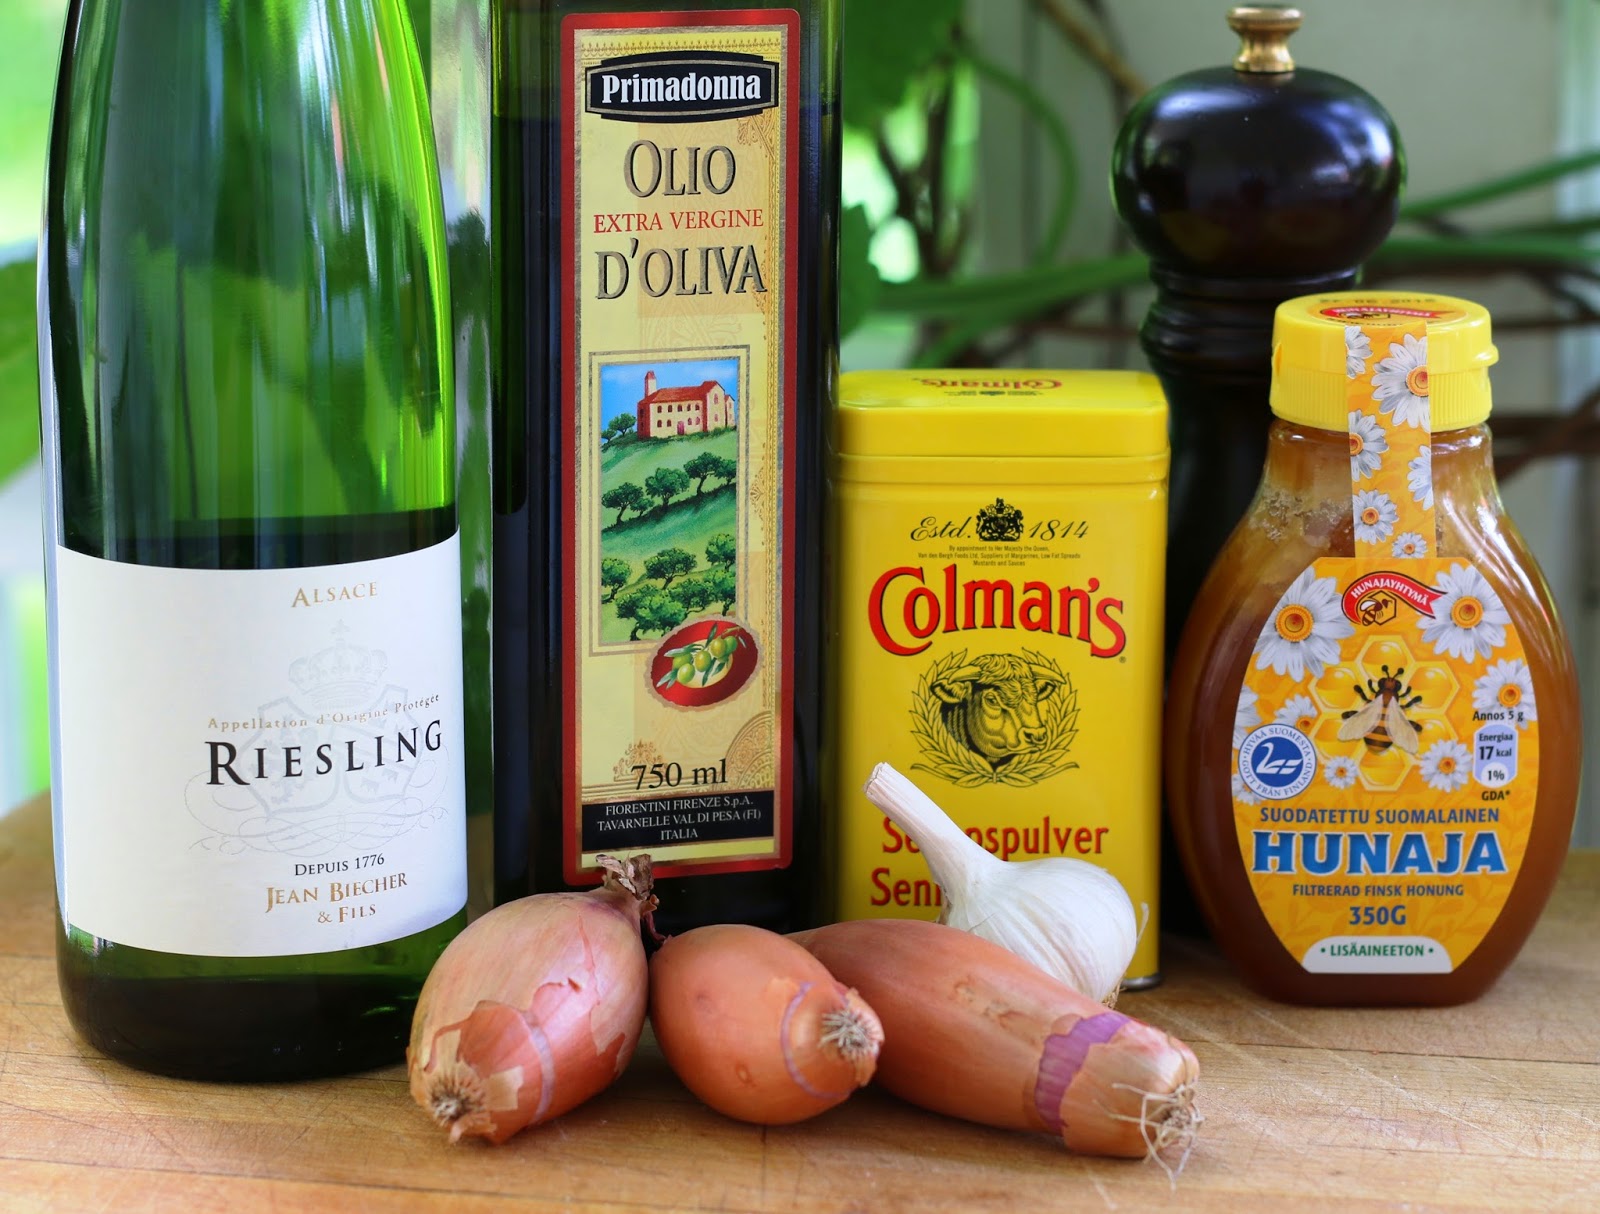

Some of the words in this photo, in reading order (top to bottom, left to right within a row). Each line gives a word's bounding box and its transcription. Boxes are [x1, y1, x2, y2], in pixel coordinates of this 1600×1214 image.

[601, 72, 761, 104] Primadonna
[624, 139, 736, 198] OLIO
[593, 212, 663, 233] EXTRA
[669, 209, 764, 230] VERGINE
[595, 237, 767, 300] D'OLIVA
[910, 516, 972, 542] Estd.
[1028, 519, 1089, 542] 1814
[291, 581, 379, 608] ALSACE
[1350, 577, 1429, 605] HUNAJAYHTYMÄ
[868, 563, 1127, 659] Colman's
[208, 717, 308, 732] Appellation
[316, 708, 388, 725] d'Origine
[1472, 710, 1505, 721] Annos
[1508, 710, 1514, 720] 5
[1517, 711, 1524, 722] g
[1269, 727, 1311, 757] SUOMESTA
[1479, 733, 1513, 743] Energiaa
[204, 719, 442, 785] RIESLING
[1479, 746, 1494, 760] 17
[1496, 748, 1512, 757] kcal
[631, 762, 682, 790] 750
[692, 758, 728, 786] ml
[1242, 760, 1257, 785] GOTT
[1284, 762, 1313, 796] FINLAND
[1488, 770, 1505, 781] 1%
[605, 801, 671, 816] FIORENTINI
[673, 797, 721, 812] FIRENZE
[1260, 807, 1370, 824] SUODATETTU
[1375, 808, 1499, 824] SUOMALAINEN
[597, 816, 670, 831] TAVARNELLE
[673, 814, 695, 825] VAL
[697, 812, 710, 823] DI
[712, 811, 741, 822] PESA
[742, 809, 761, 821] (FI)
[660, 829, 699, 841] ITALIA
[294, 860, 349, 876] DEPUIS
[354, 853, 385, 870] 1776
[1252, 829, 1508, 876] HUNAJA
[265, 886, 318, 913] JEAN
[329, 872, 408, 902] BIECHER
[1293, 884, 1360, 896] FILTRERAD
[1365, 885, 1401, 896] FINSK
[1406, 885, 1464, 896] HONUNG
[317, 910, 332, 923] &
[339, 904, 376, 923] FILS
[1349, 905, 1406, 925] 350G
[1330, 943, 1424, 957] LISÄAINEETON
